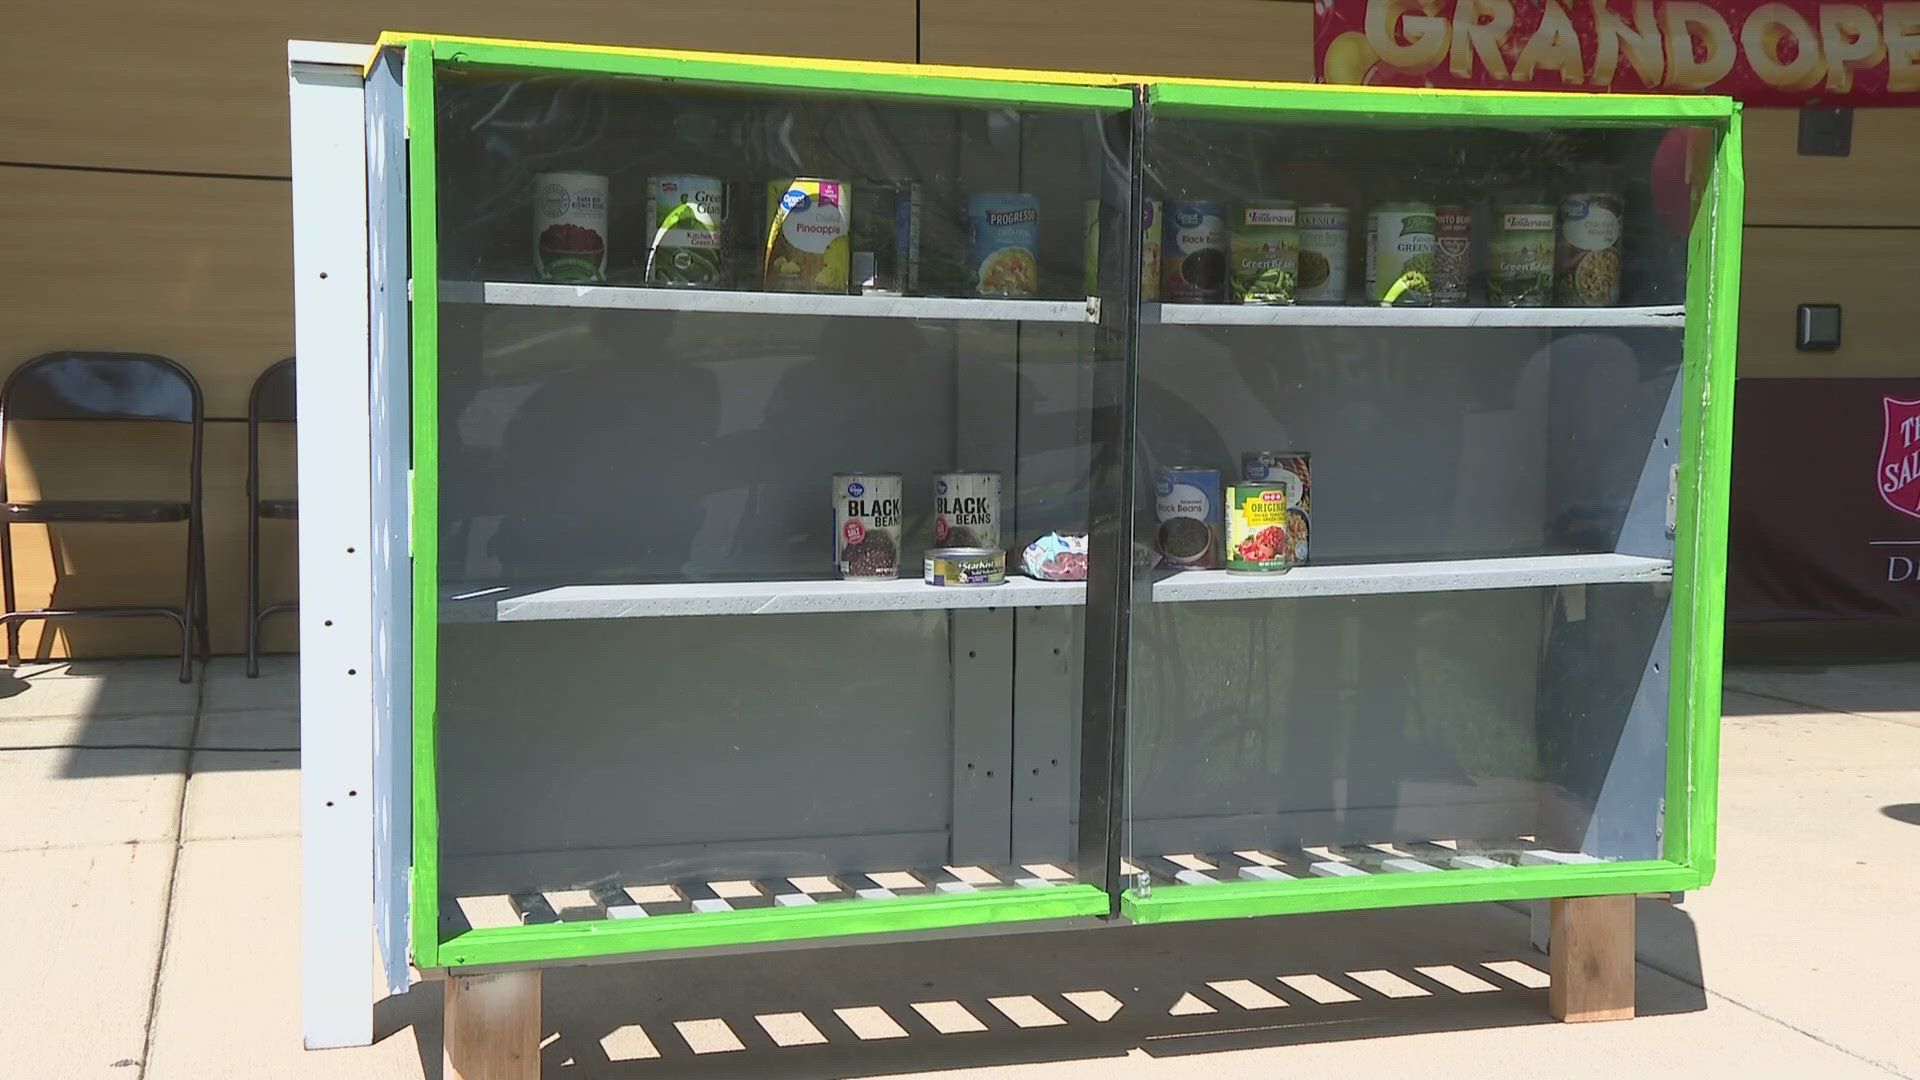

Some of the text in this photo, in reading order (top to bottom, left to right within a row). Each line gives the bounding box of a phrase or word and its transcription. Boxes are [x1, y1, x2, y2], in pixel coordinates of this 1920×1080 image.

[990, 209, 1036, 226] PROGRESSO
[796, 223, 841, 236] Pineapple
[1242, 258, 1270, 268] Green
[848, 498, 900, 517] BLACK
[937, 496, 986, 515] BLACK
[1177, 503, 1202, 513] Beans
[955, 513, 991, 526] BEANS
